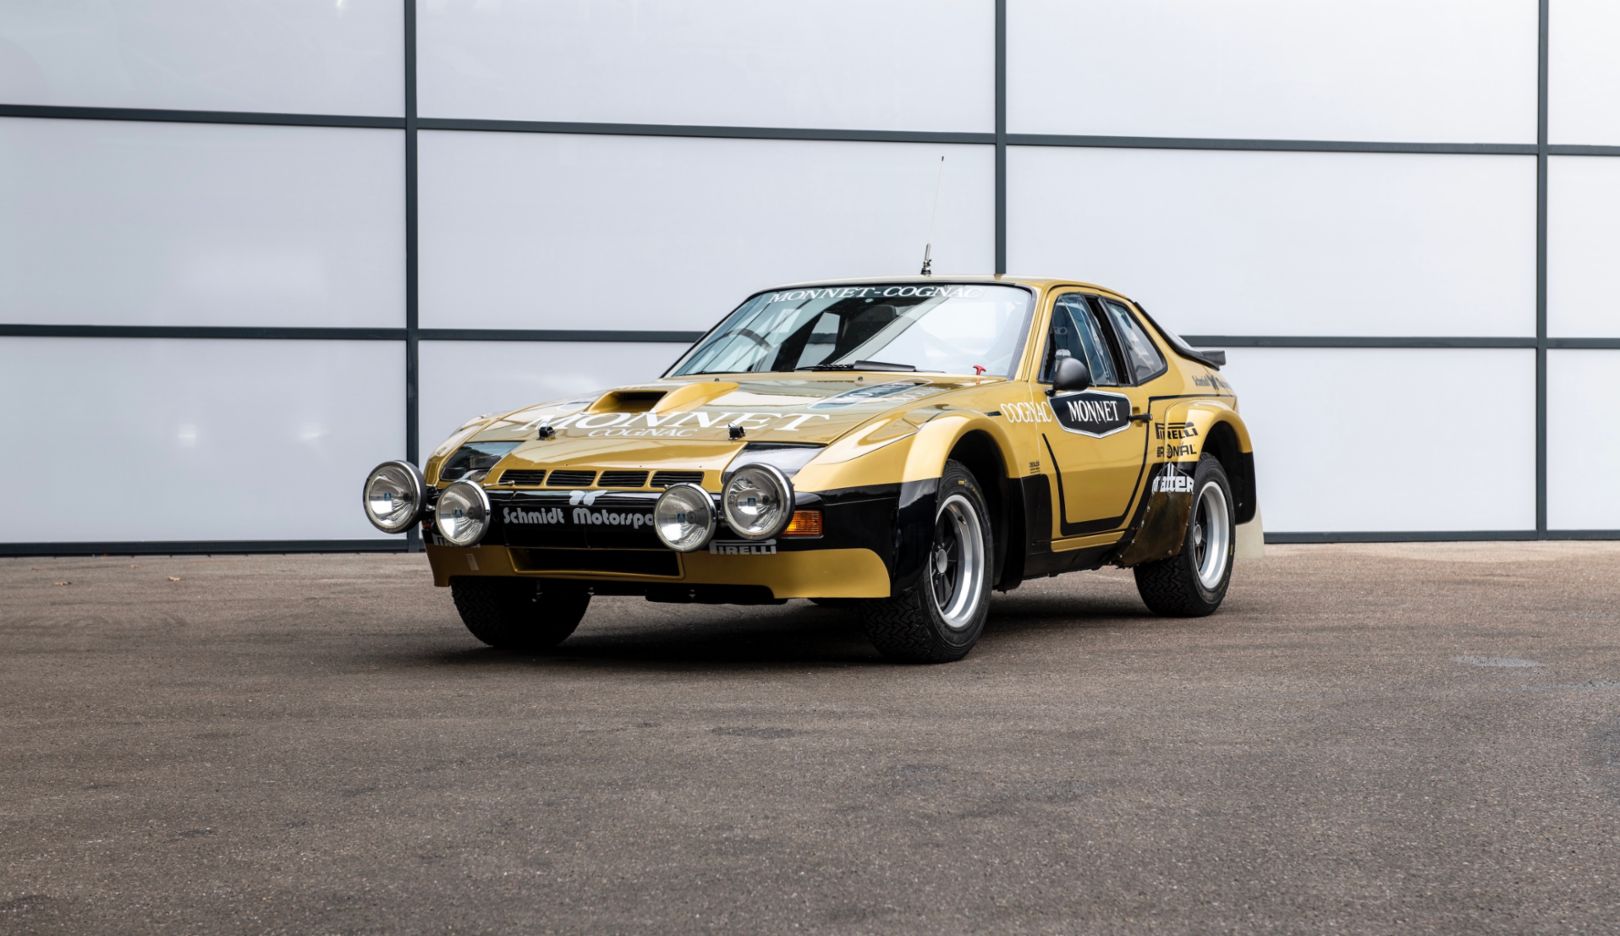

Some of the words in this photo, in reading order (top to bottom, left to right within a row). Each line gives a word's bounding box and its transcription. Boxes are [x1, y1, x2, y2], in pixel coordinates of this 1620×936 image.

[511, 411, 830, 432] MONNET
[1000, 400, 1052, 424] COGNAC
[1066, 400, 1120, 424] MONNET
[588, 427, 699, 437] COGNAC
[1155, 422, 1198, 439] PIRELLI
[1157, 444, 1197, 458] RONAL
[503, 507, 565, 525] Schmidt
[573, 508, 654, 529] Motorspo
[709, 539, 776, 555] PIRELLI
